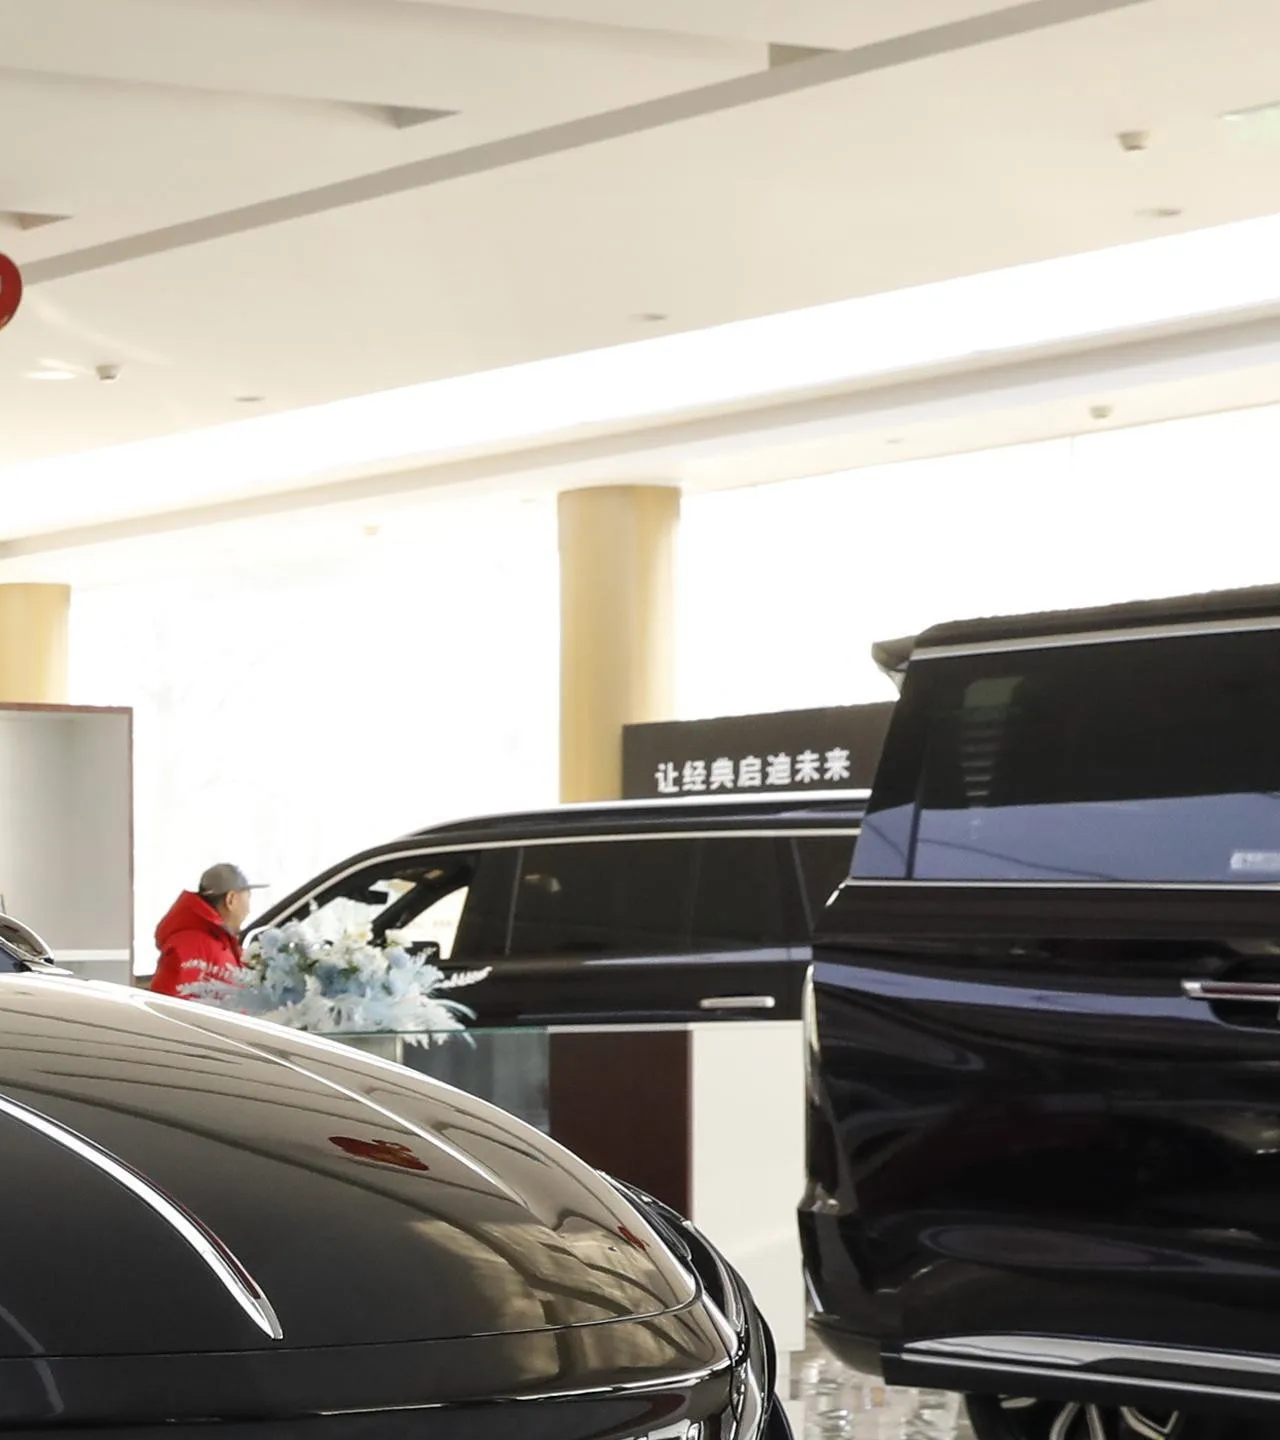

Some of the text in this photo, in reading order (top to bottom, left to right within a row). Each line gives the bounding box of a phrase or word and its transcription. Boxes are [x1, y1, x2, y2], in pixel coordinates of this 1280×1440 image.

[654, 747, 850, 793] 让经典启迪未来
